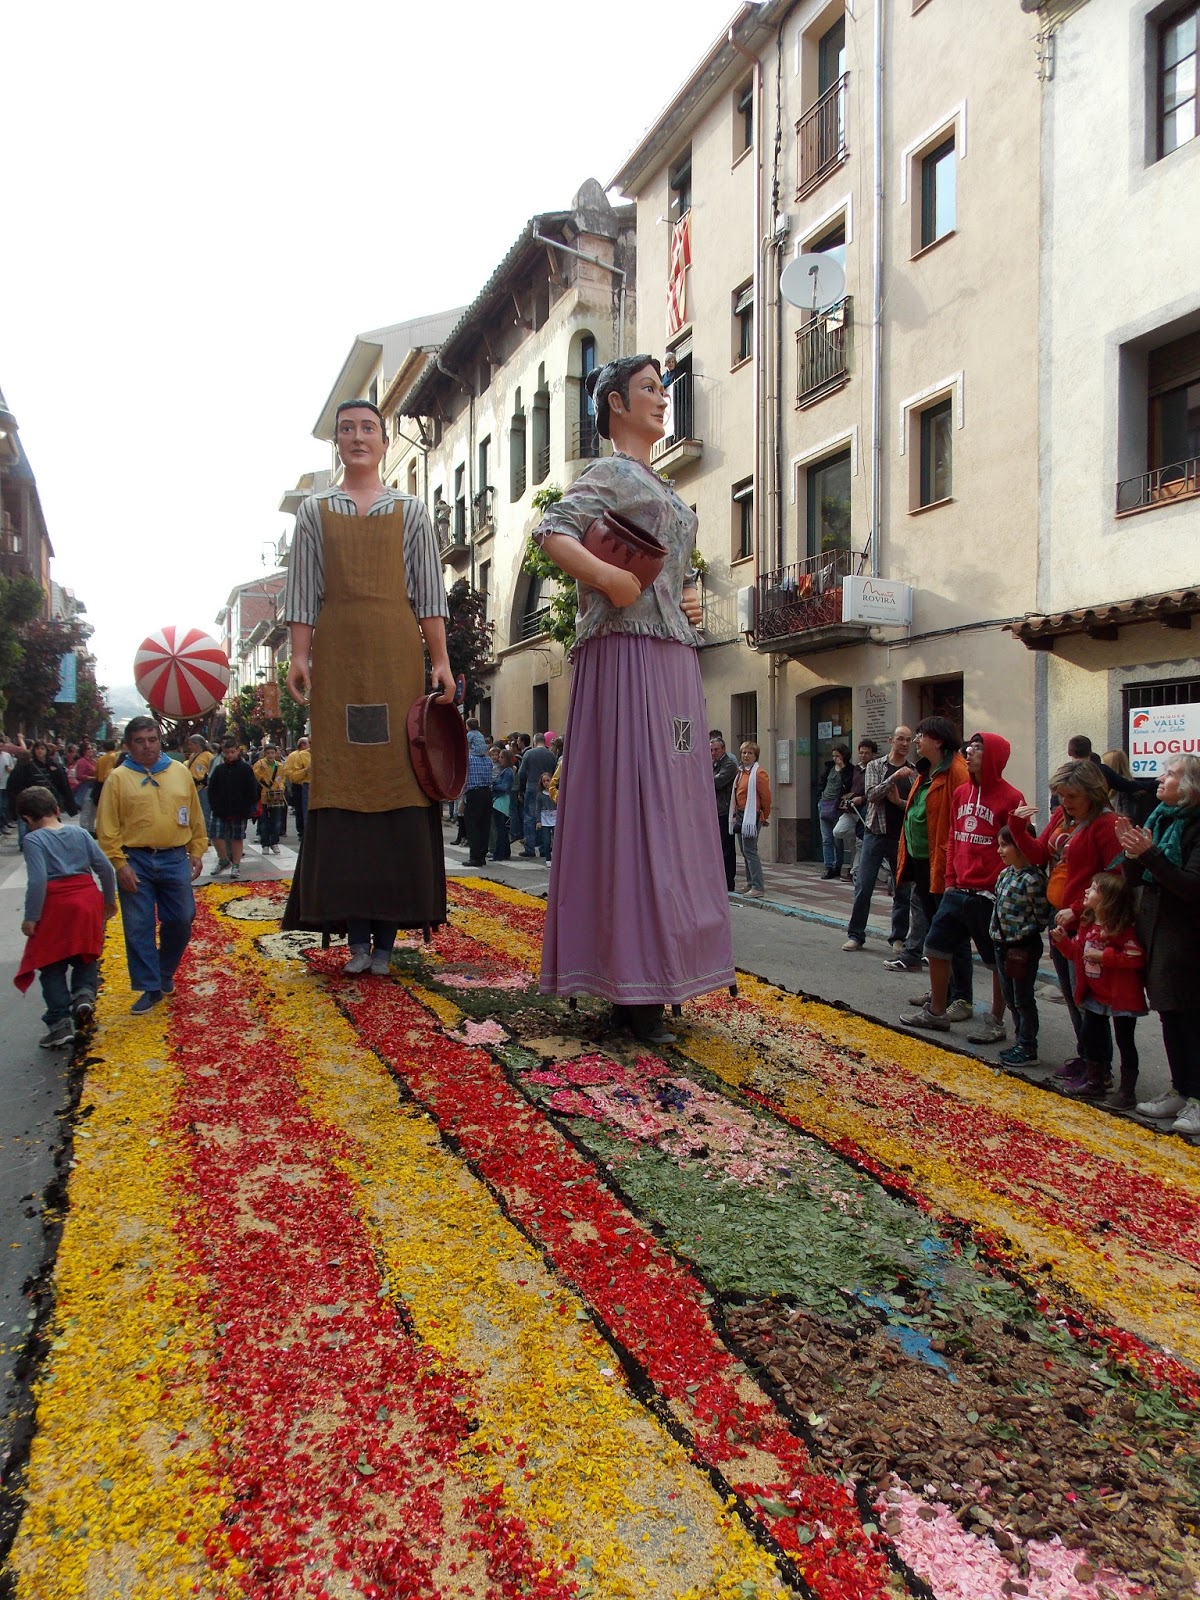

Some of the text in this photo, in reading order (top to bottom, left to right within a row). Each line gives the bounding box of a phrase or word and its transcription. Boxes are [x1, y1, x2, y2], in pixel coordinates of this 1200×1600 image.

[862, 594, 896, 605] ROVIRA
[866, 697, 887, 705] ROVIRA
[1154, 718, 1185, 727] VALLS
[1132, 759, 1157, 772] 972
[969, 833, 994, 845] THREE
